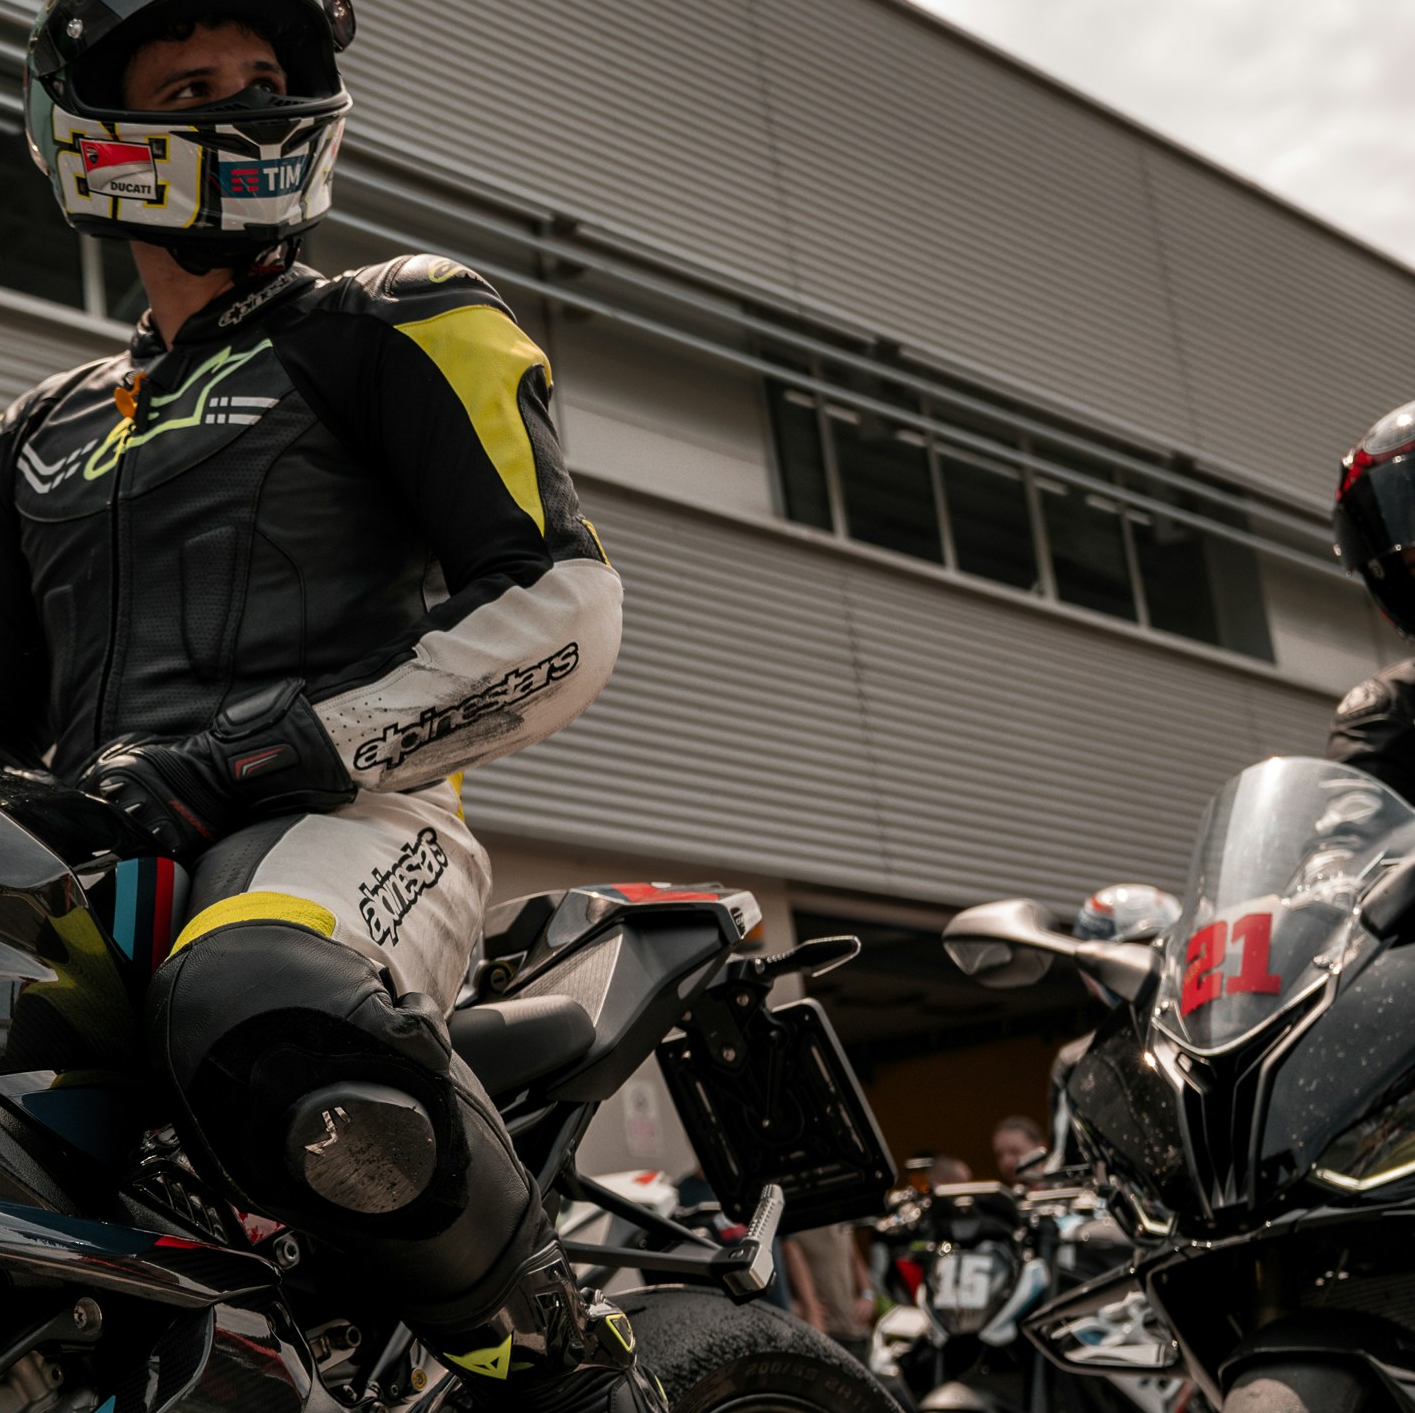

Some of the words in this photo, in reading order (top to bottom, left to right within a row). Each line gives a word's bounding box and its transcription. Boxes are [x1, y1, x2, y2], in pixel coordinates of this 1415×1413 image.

[110, 181, 151, 195] DUCATI
[262, 163, 302, 191] TIM
[353, 642, 579, 770] alpinestars
[1181, 913, 1282, 1018] 21
[934, 1254, 993, 1308] 15
